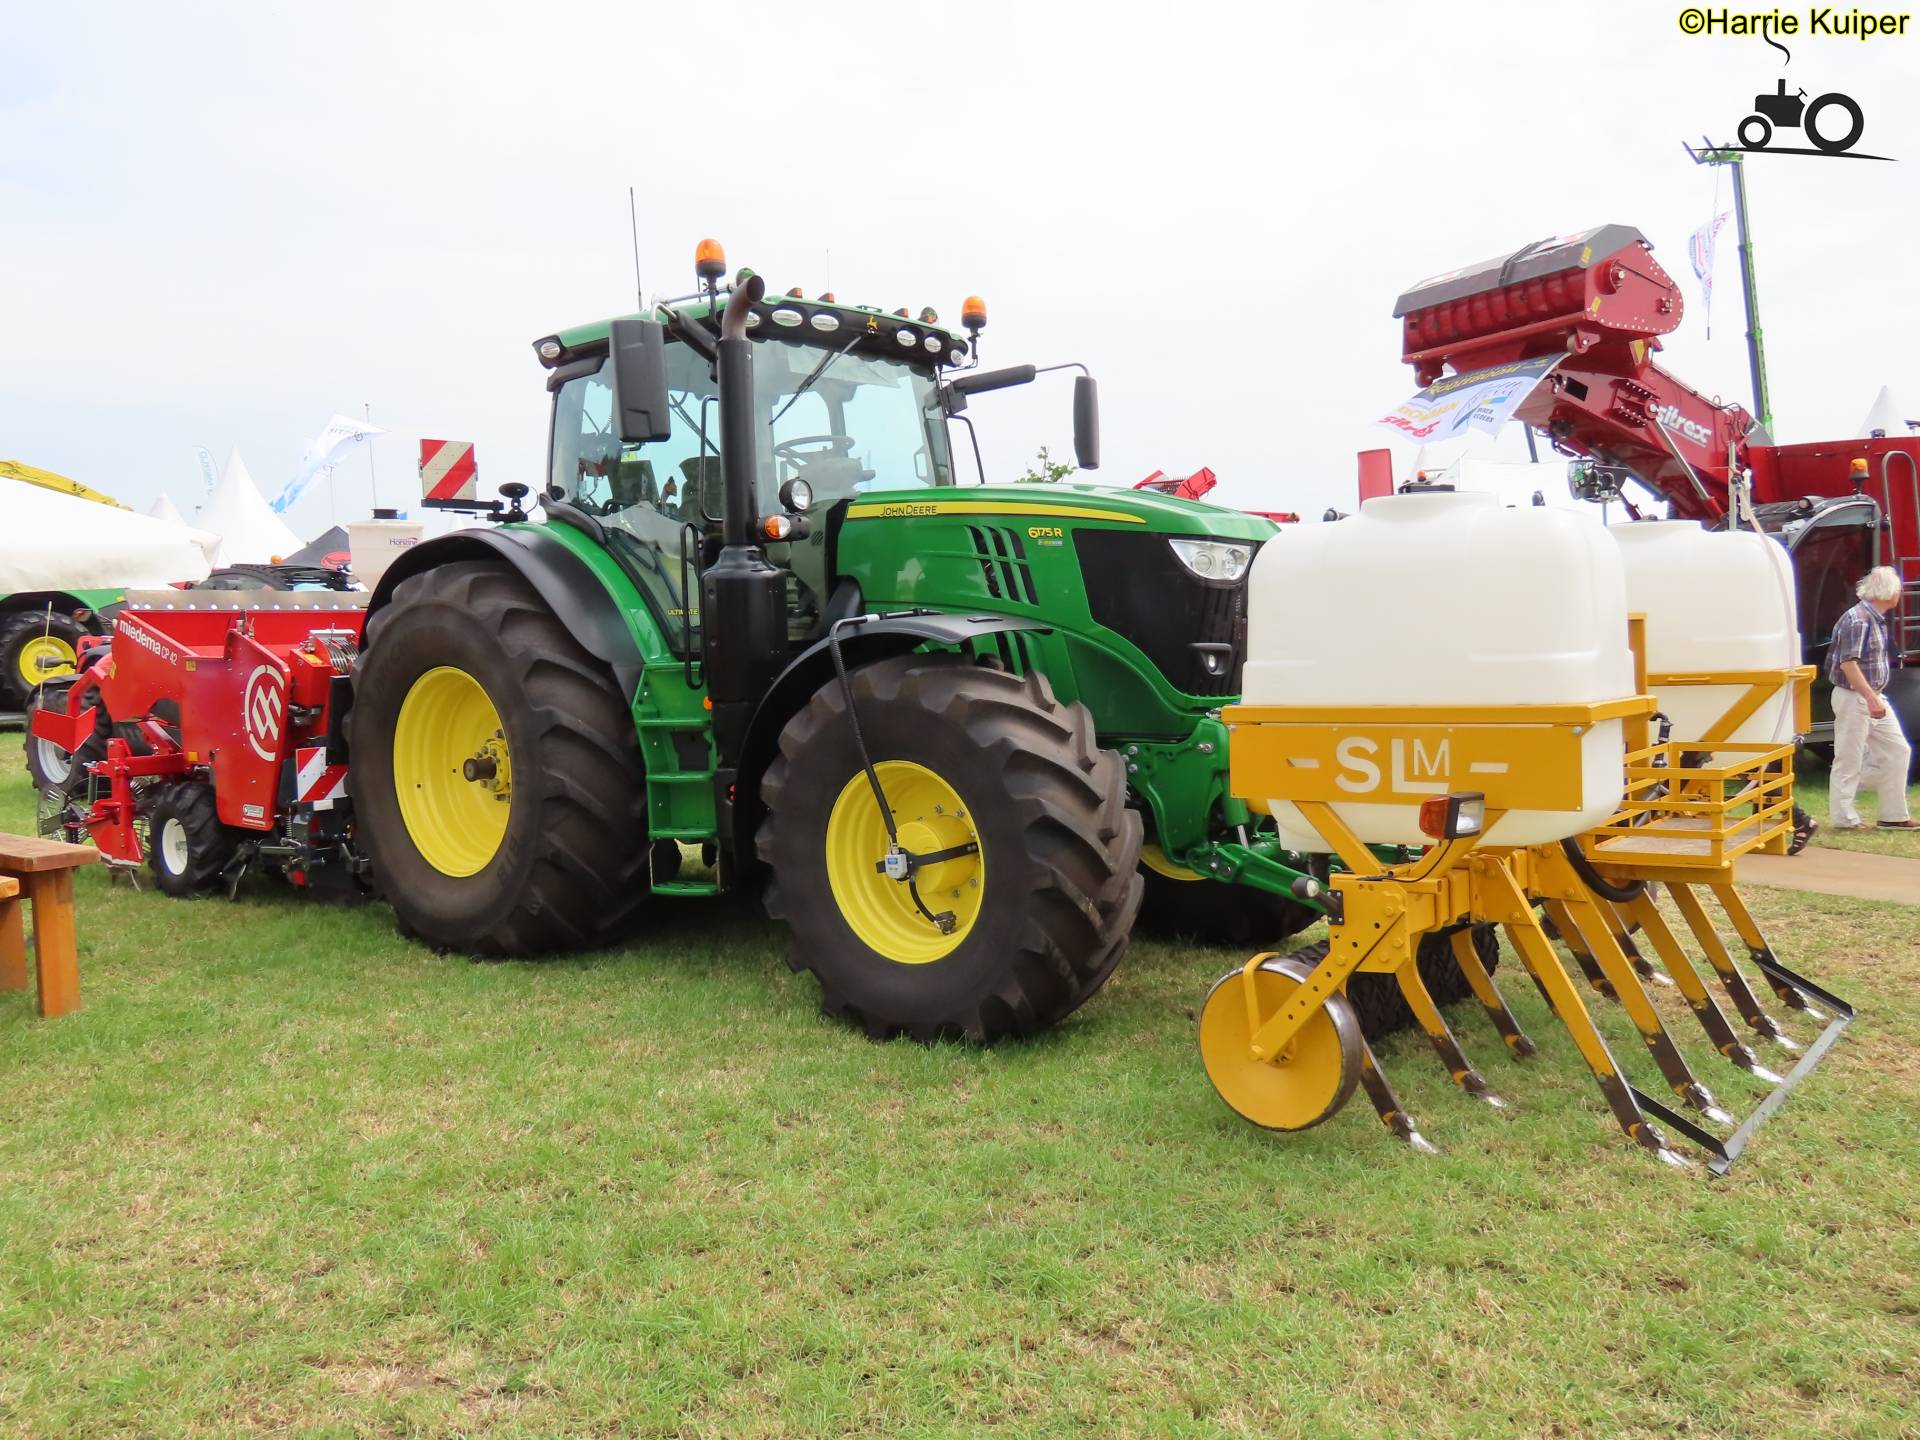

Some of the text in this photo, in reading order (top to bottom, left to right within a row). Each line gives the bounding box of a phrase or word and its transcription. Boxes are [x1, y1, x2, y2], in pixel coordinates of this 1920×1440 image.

[880, 504, 937, 516] JOHN DEERE
[120, 620, 160, 655] miedema
[1335, 736, 1450, 794] SLM
